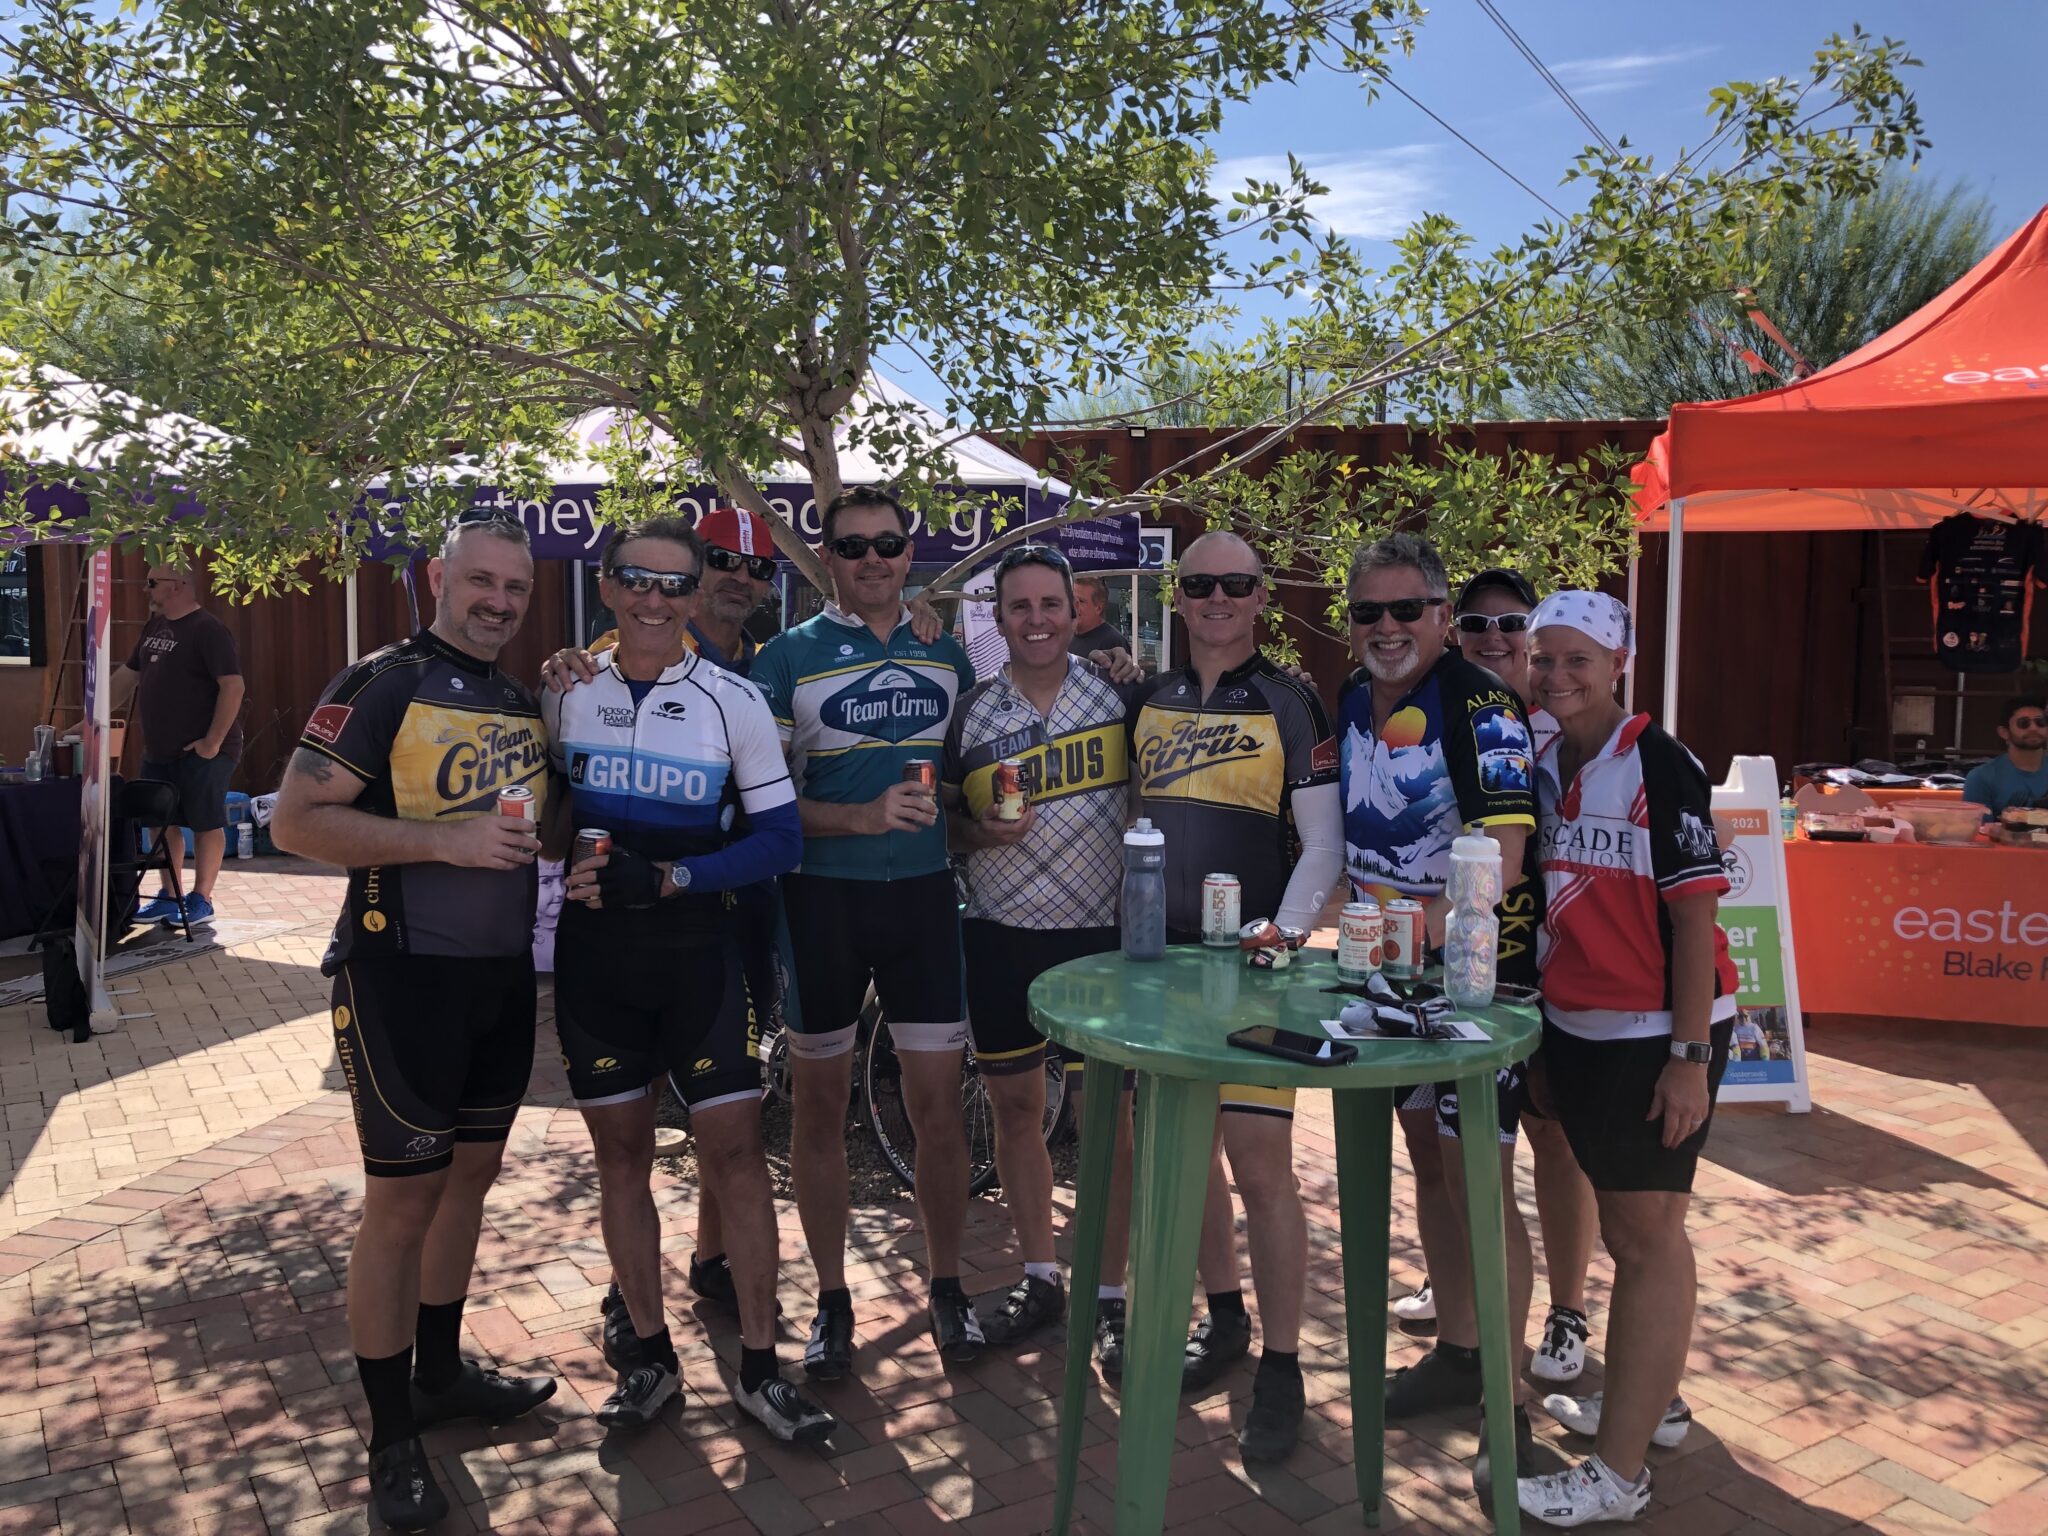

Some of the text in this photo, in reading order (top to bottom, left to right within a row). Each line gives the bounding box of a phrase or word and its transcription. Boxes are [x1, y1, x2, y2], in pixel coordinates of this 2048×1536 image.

[1942, 364, 2048, 384] ea
[597, 704, 634, 717] JACKSON
[840, 691, 939, 725] Team Cirrus
[477, 722, 533, 755] Team
[990, 730, 1032, 760] TEAM
[1171, 719, 1240, 747] Team
[1138, 734, 1264, 780] Cirrus
[572, 755, 707, 802] el GRUPO
[1731, 817, 1760, 829] 2021
[1720, 924, 1758, 948] er
[1893, 900, 2048, 946] easte
[1943, 951, 2033, 982] Blake
